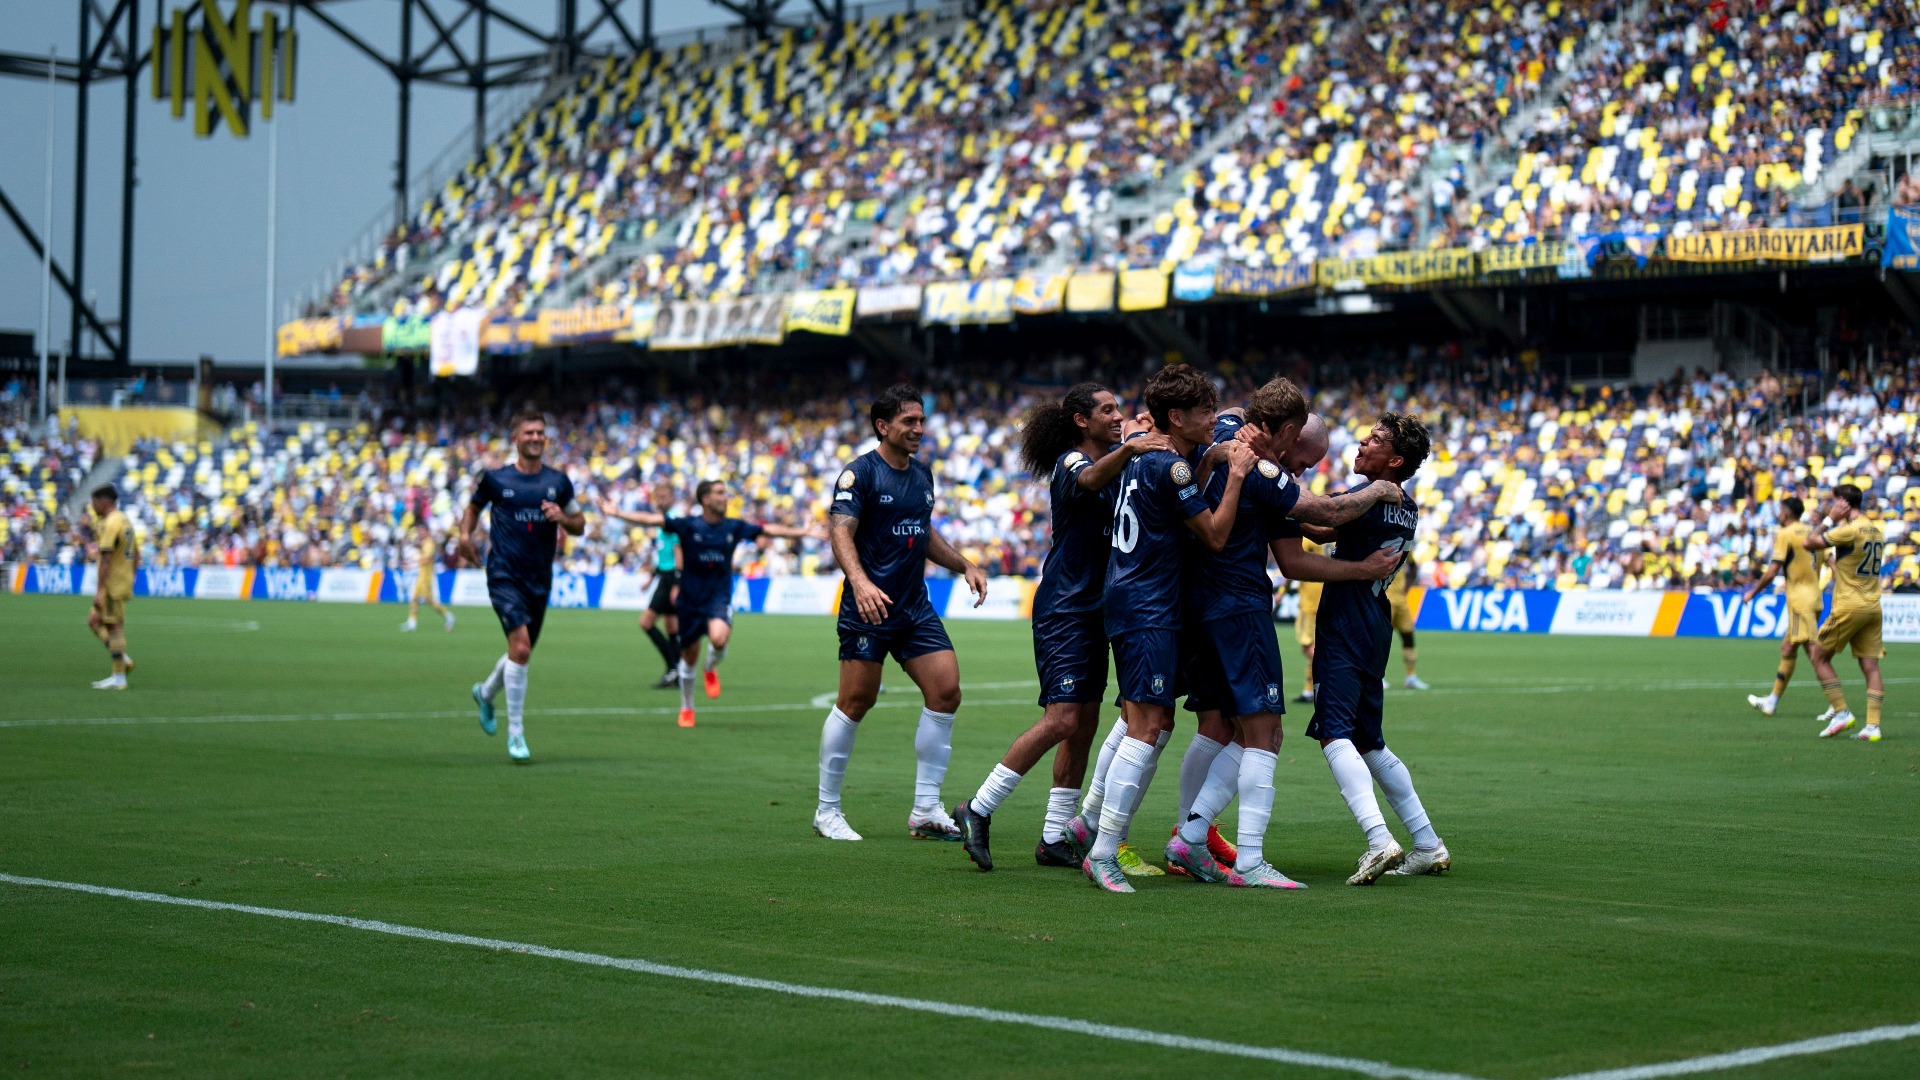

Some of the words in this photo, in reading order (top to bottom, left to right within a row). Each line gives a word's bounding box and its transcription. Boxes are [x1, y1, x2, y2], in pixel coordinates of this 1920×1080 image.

[1722, 230, 1858, 257] FERROVIARIA
[1856, 540, 1883, 577] 26
[265, 567, 307, 599] VISA
[1440, 589, 1529, 631] VISA
